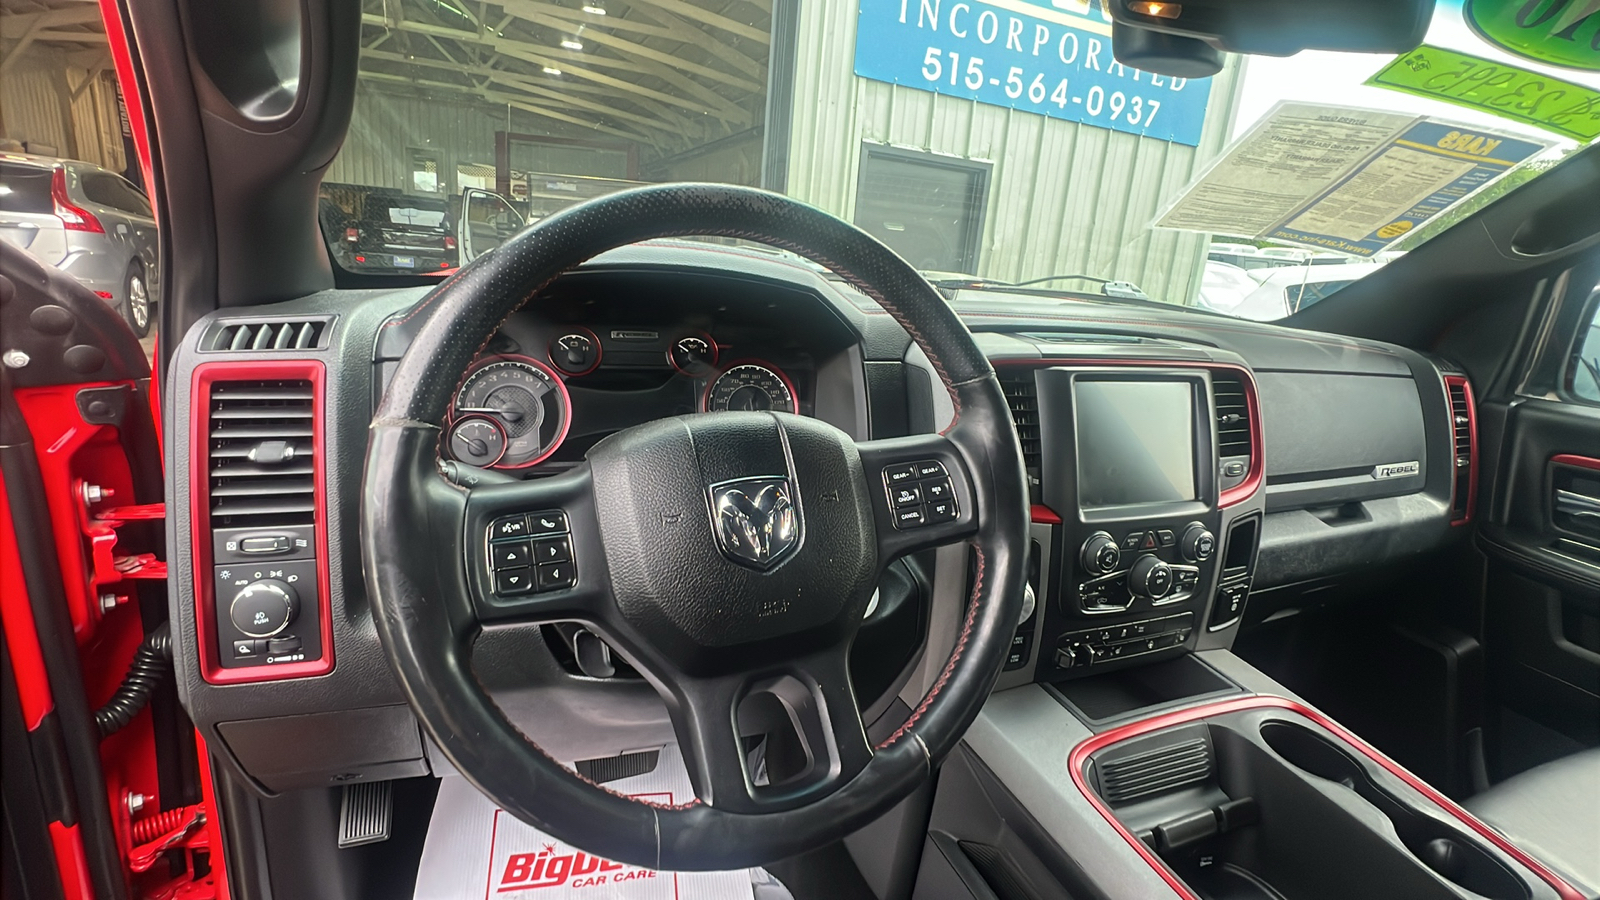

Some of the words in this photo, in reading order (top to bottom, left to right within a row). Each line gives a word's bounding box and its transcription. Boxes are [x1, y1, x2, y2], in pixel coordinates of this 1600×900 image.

[921, 46, 1161, 129] 515-564-0937
[1380, 465, 1416, 477] REBEL
[900, 511, 920, 520] CANCEL
[253, 617, 270, 626] PUSH
[572, 876, 606, 888] CAR
[613, 870, 657, 883] CARE
